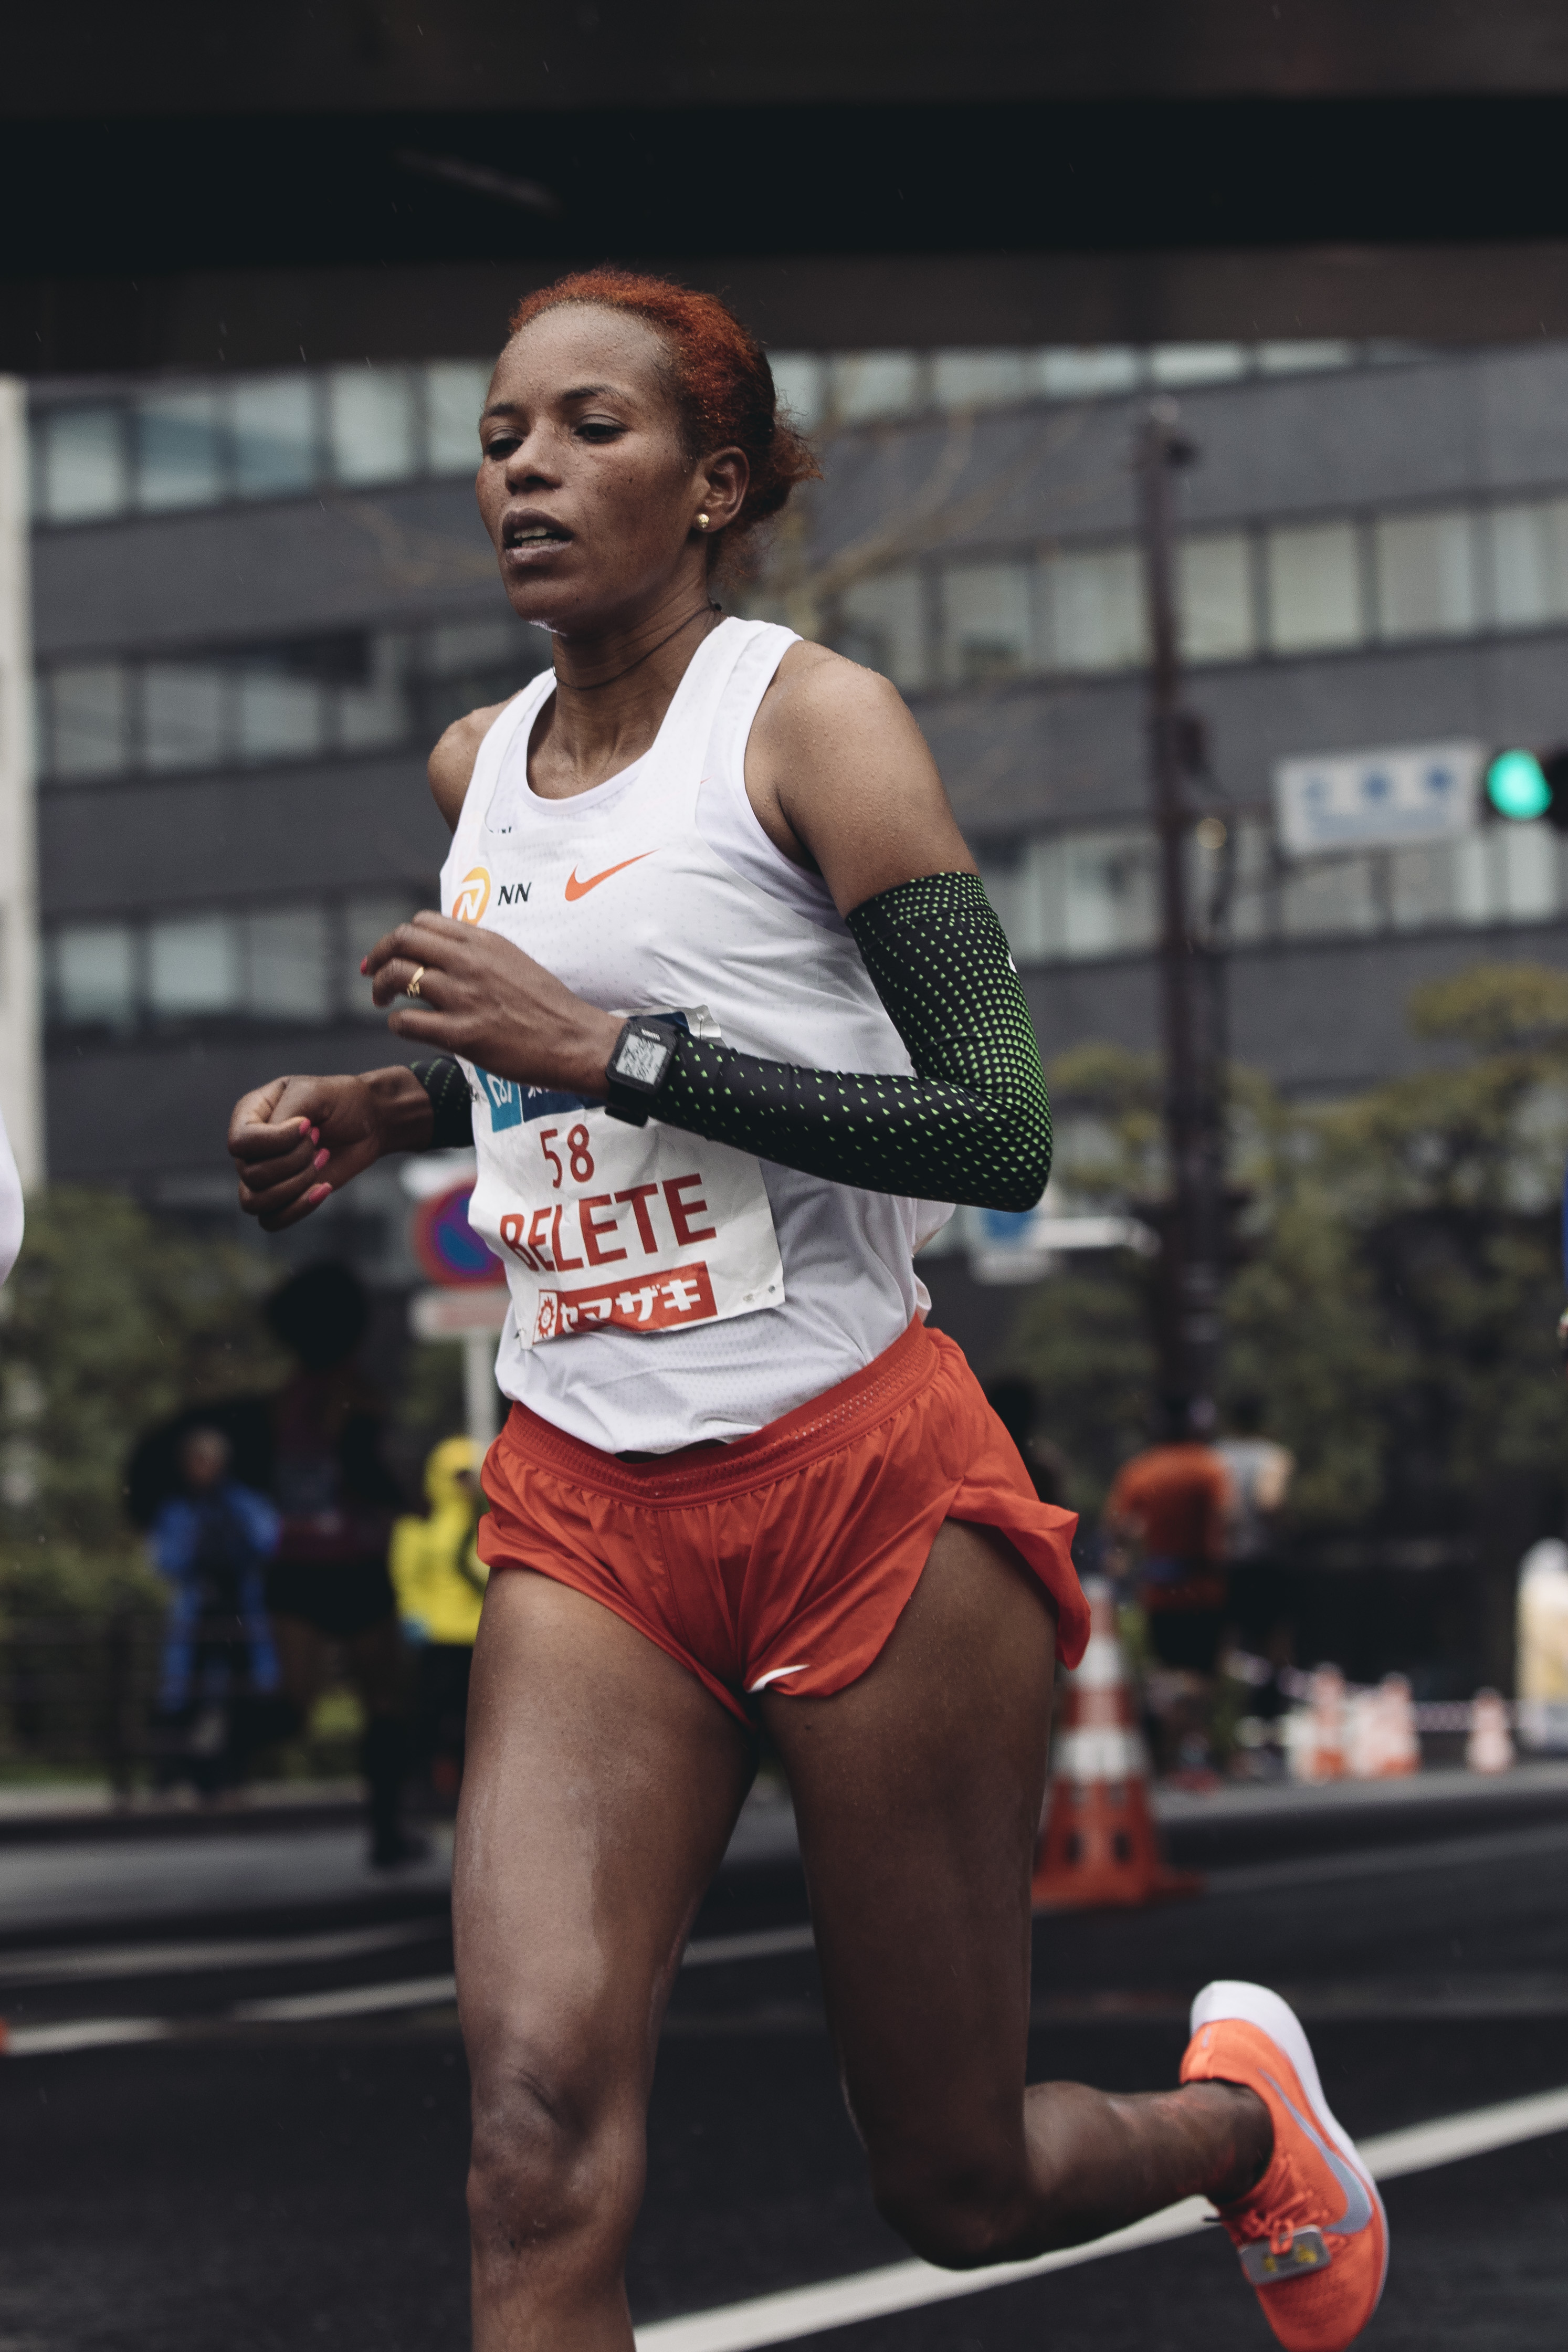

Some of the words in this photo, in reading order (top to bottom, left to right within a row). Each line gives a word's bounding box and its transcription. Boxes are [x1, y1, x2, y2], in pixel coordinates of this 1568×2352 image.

[498, 881, 532, 906] NN
[540, 1123, 595, 1189] 58
[500, 1172, 718, 1273] BELETE
[560, 1279, 701, 1334] ヤマザキ
